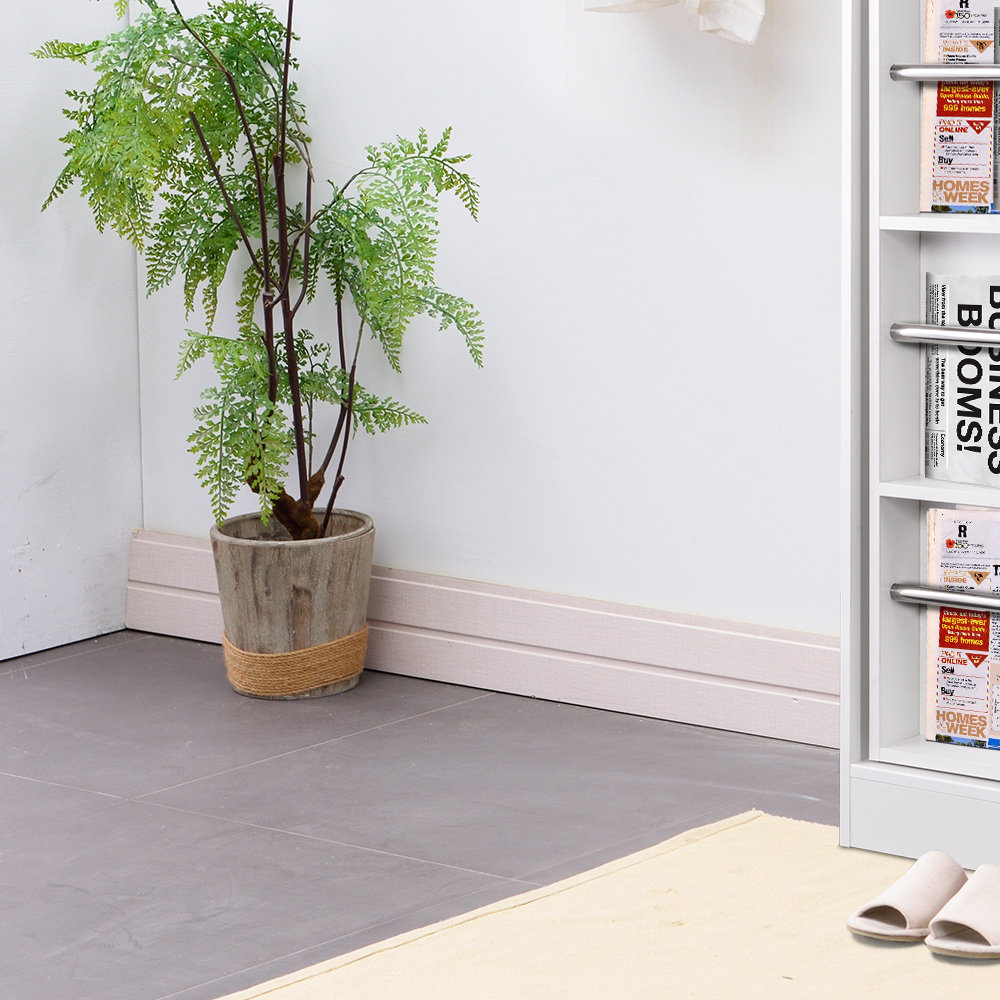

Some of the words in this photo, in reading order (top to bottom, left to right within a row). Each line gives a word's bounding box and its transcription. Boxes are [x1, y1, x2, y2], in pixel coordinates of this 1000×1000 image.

[938, 156, 953, 165] Buy
[932, 180, 990, 192] HOMES
[944, 192, 989, 203] WEEK
[958, 525, 967, 537] R
[941, 687, 955, 696] Buy
[936, 710, 987, 726] HOMES
[946, 722, 986, 738] WEEK
